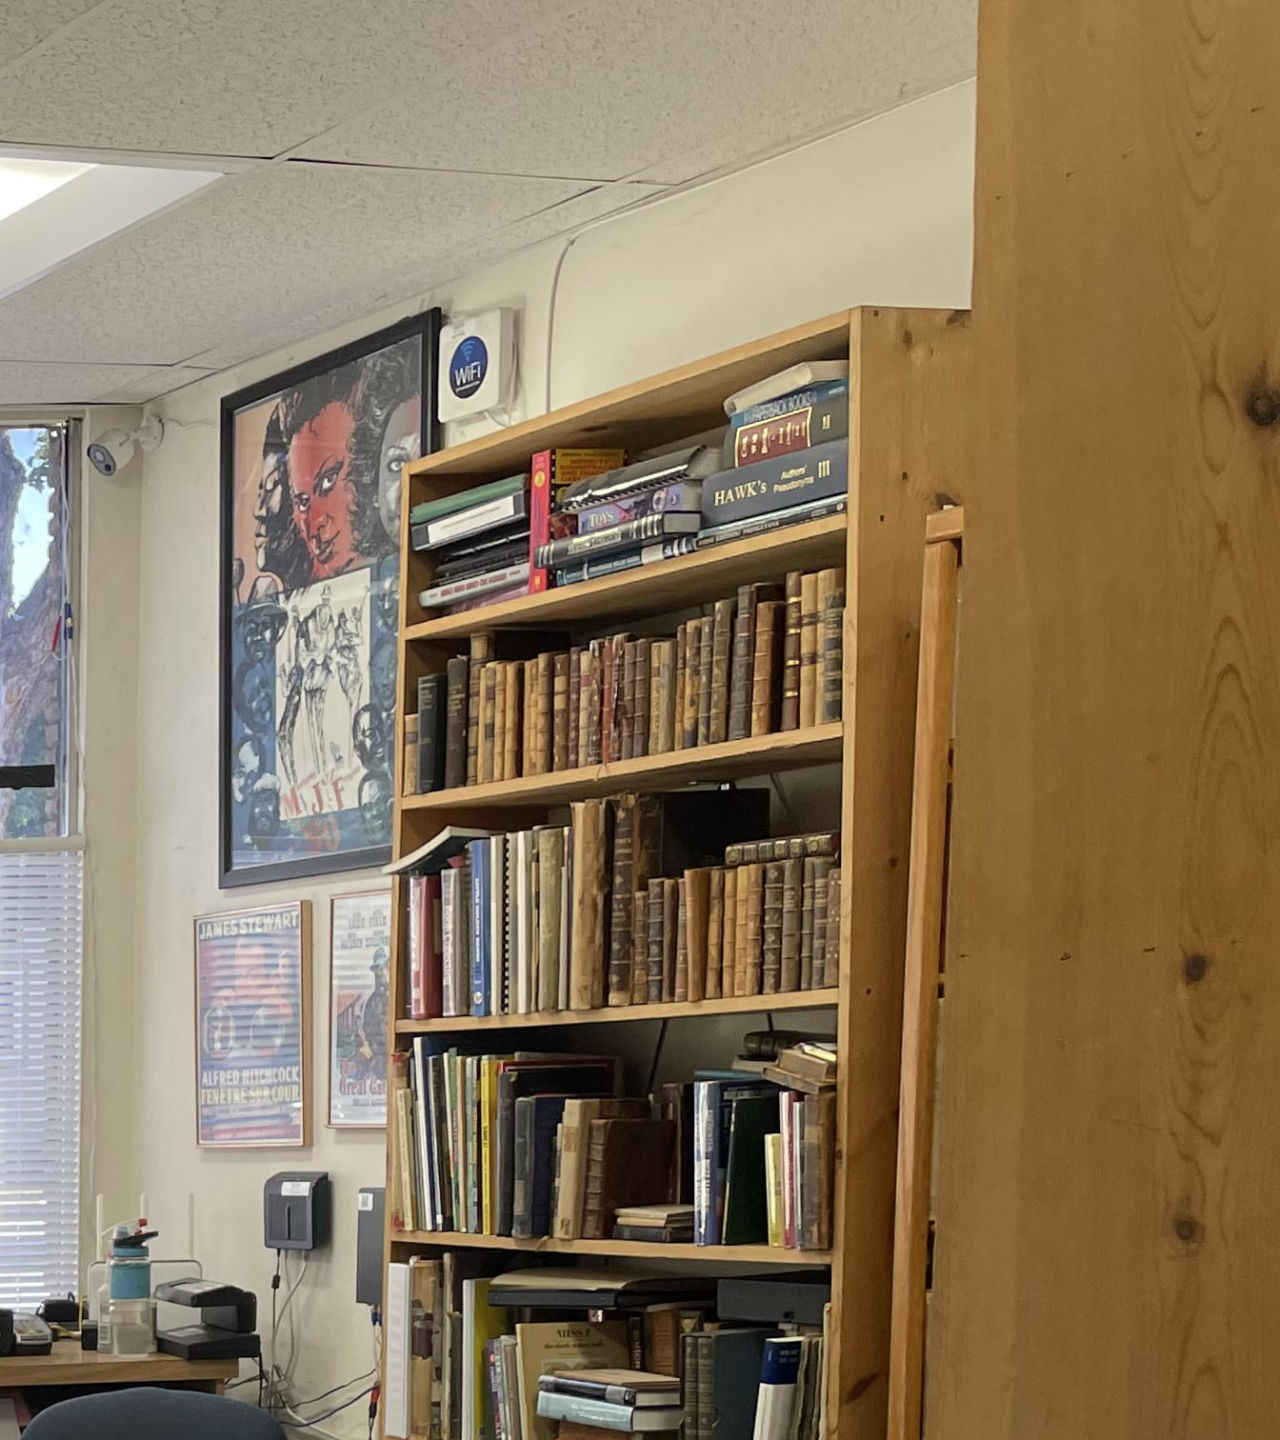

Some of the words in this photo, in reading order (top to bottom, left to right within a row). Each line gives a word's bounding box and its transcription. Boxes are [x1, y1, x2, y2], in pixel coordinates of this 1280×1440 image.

[455, 361, 481, 387] WiFi
[713, 478, 768, 507] HAWK's
[199, 918, 238, 941] JAMES
[239, 911, 298, 937] STEWART
[201, 1069, 240, 1087] ALFRED
[241, 1065, 300, 1085] HITCHCOCK
